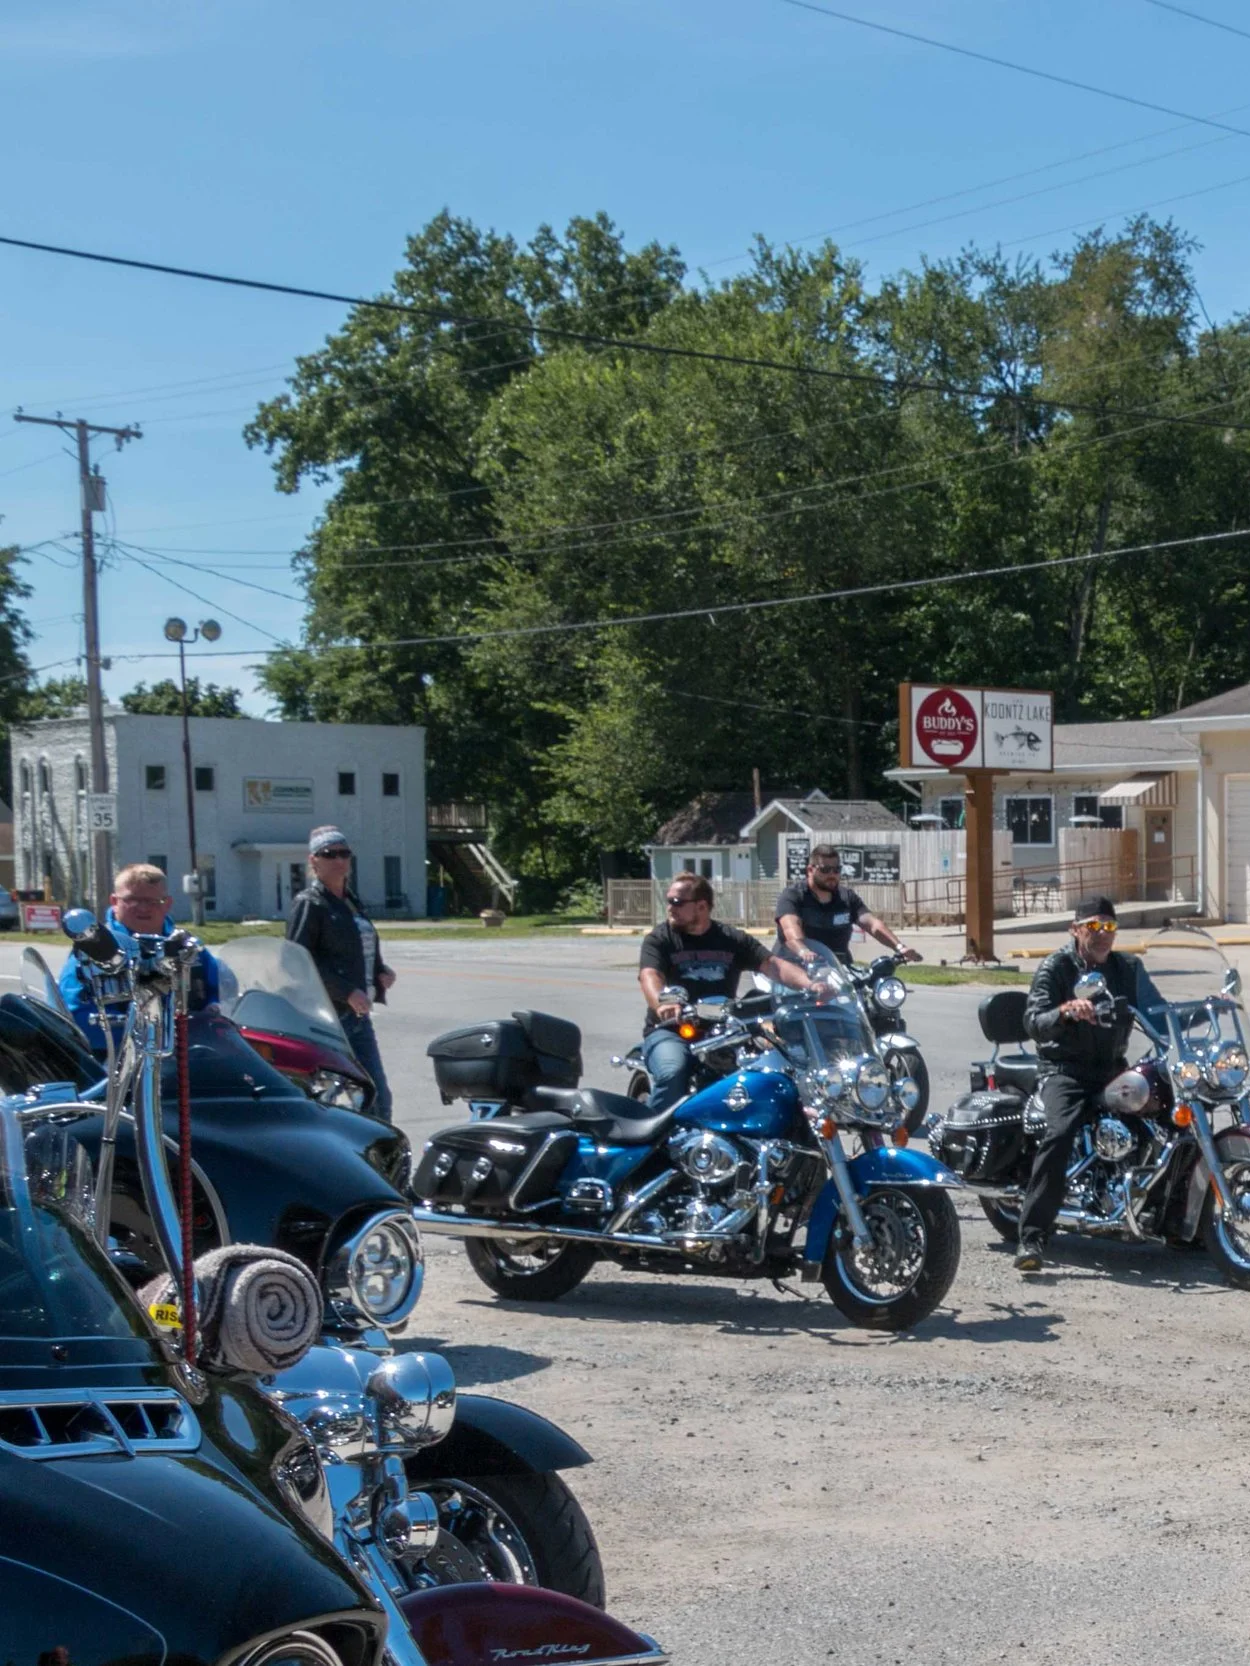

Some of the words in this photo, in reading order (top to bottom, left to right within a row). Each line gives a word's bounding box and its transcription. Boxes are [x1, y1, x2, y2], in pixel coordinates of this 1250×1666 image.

[983, 702, 1024, 721] KOONTZ
[1027, 703, 1051, 722] LAKE
[922, 715, 975, 731] BUDDY'S
[93, 812, 114, 827] 35
